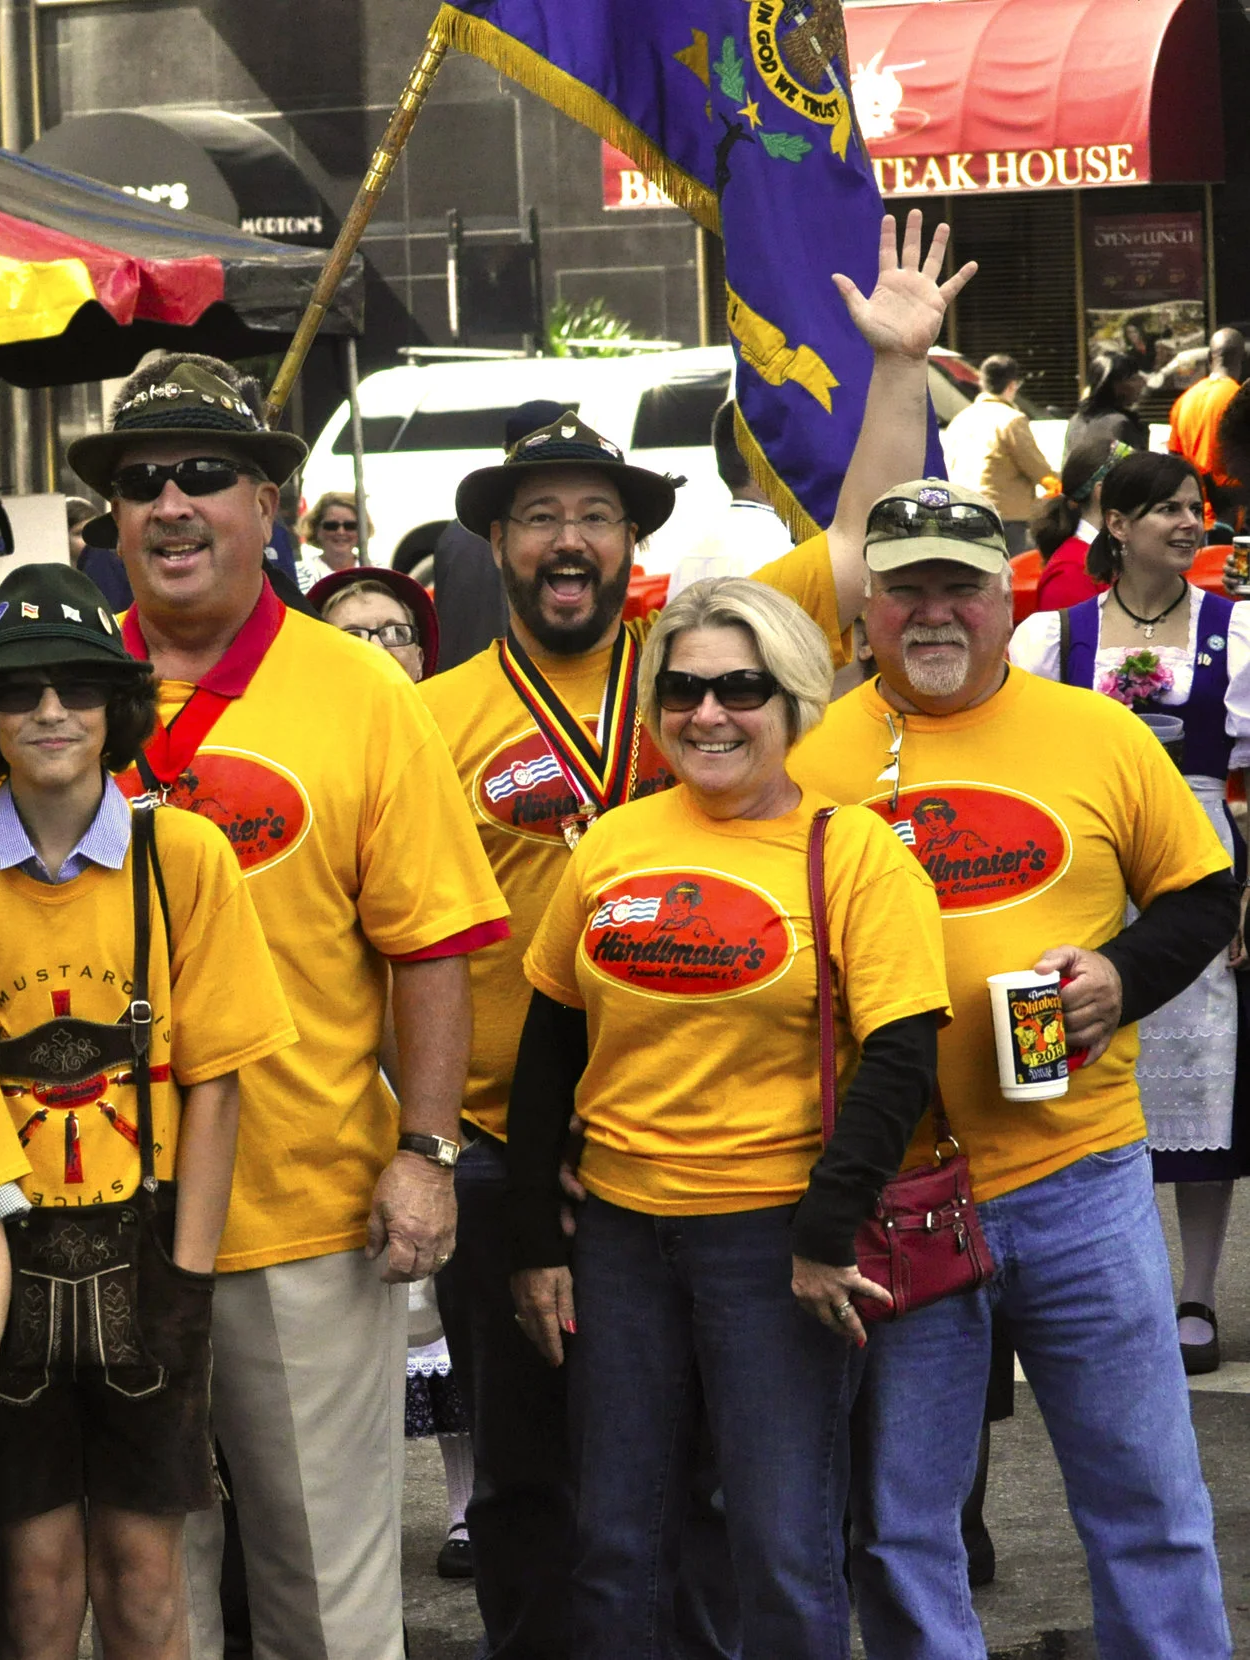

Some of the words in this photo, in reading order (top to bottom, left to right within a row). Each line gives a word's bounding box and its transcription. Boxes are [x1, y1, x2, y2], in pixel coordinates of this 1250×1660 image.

[757, 29, 778, 73] GOD
[774, 73, 799, 103] WE
[802, 94, 840, 118] TRUST
[986, 142, 1136, 188] HOUSE
[240, 216, 324, 235] MORTON'S
[1143, 229, 1194, 245] LUNCH
[593, 930, 765, 970] Händlmaier's
[1035, 1043, 1064, 1064] 2013
